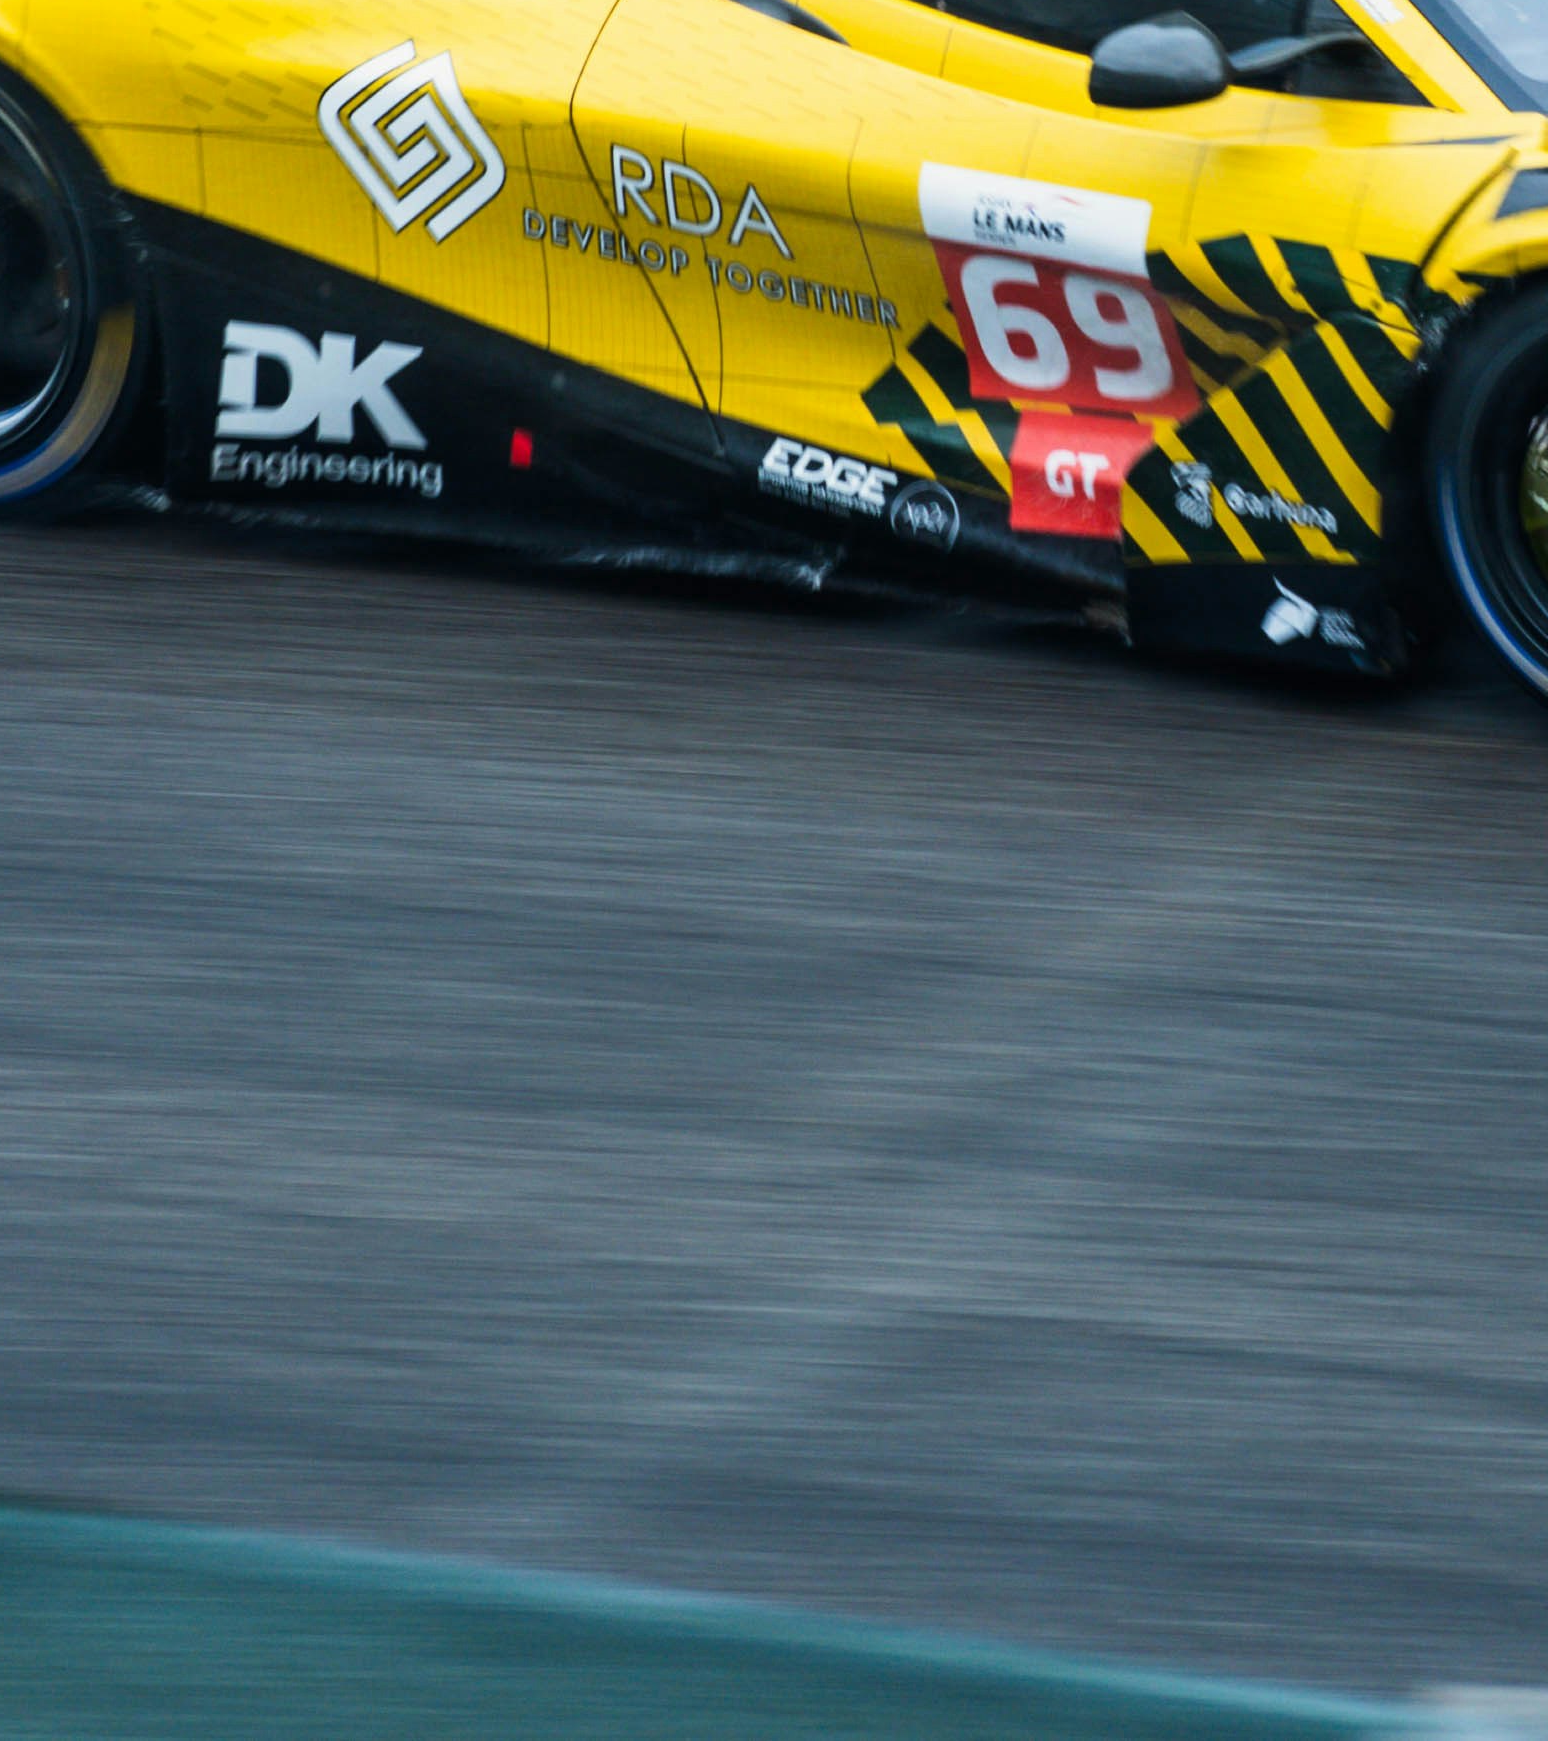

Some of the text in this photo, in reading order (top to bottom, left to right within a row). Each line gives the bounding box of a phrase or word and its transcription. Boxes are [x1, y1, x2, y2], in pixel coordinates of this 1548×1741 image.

[611, 143, 794, 260] RDA
[973, 205, 1066, 243] LE MANS
[522, 206, 902, 330] DEVELOP TOGETHER
[960, 254, 1175, 401] 69
[214, 319, 429, 451] DK
[209, 442, 444, 499] Engineering
[762, 436, 899, 508] EDGE
[1044, 448, 1112, 502] GT
